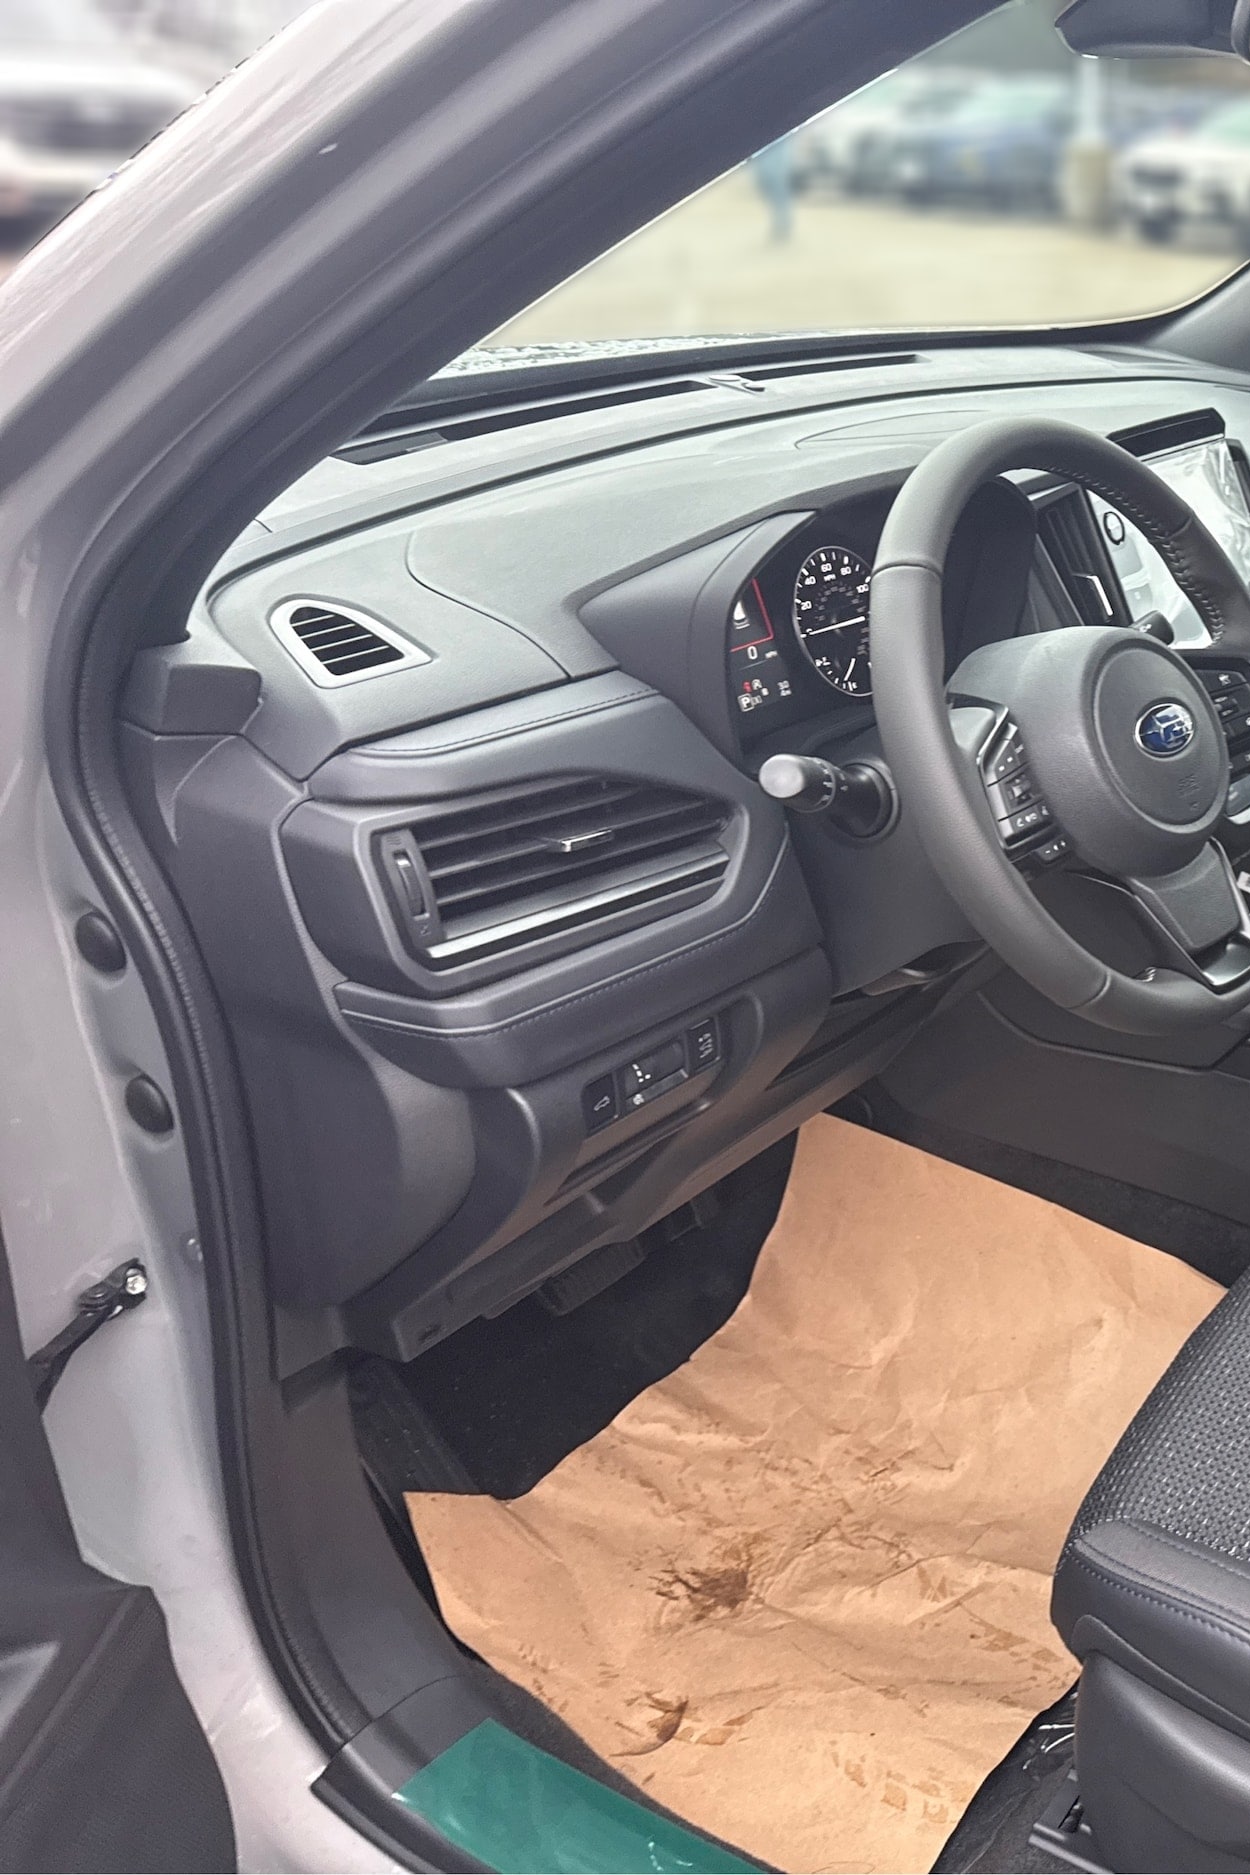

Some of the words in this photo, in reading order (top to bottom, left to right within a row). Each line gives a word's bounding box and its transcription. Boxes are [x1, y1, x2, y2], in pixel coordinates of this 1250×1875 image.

[821, 563, 833, 572] 60
[804, 576, 817, 585] 40
[856, 584, 869, 593] 100
[801, 601, 813, 611] 20
[747, 645, 758, 660] 0
